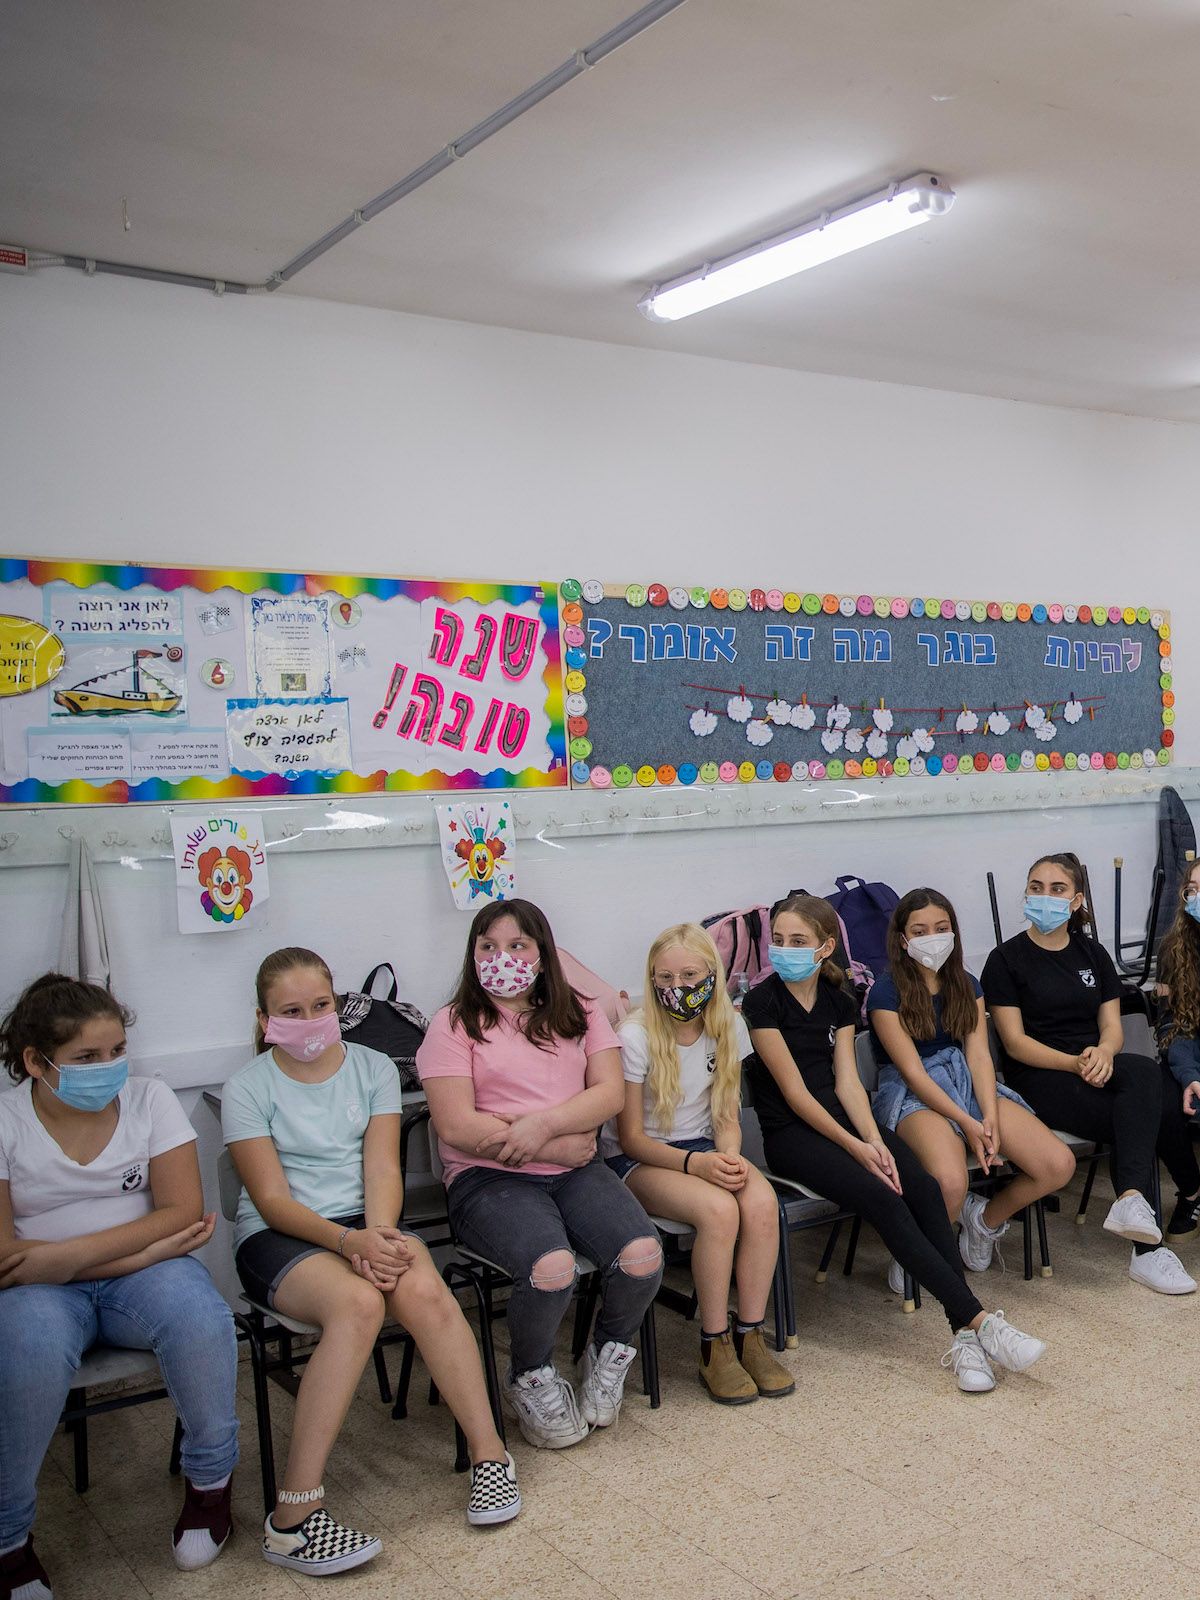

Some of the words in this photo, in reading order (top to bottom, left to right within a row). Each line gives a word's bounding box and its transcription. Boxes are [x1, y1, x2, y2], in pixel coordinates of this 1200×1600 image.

[79, 601, 113, 611] רוצה
[119, 601, 140, 611] אני
[146, 600, 168, 614] לאן
[72, 620, 112, 632] השנה
[118, 618, 170, 631] להפליג
[428, 607, 540, 683] שנה
[588, 618, 738, 664] אומר?
[765, 624, 815, 662] זה
[833, 628, 892, 663] מה
[917, 631, 997, 666] בוגר
[1044, 634, 1142, 673] להיות
[256, 714, 288, 726] ארצה
[297, 710, 324, 727] לאן
[372, 662, 531, 759] טובה!
[244, 732, 272, 747] עוף
[282, 728, 338, 746] להגביה
[208, 819, 247, 840] פורים
[181, 826, 207, 869] שמח!
[246, 840, 264, 865] חג
